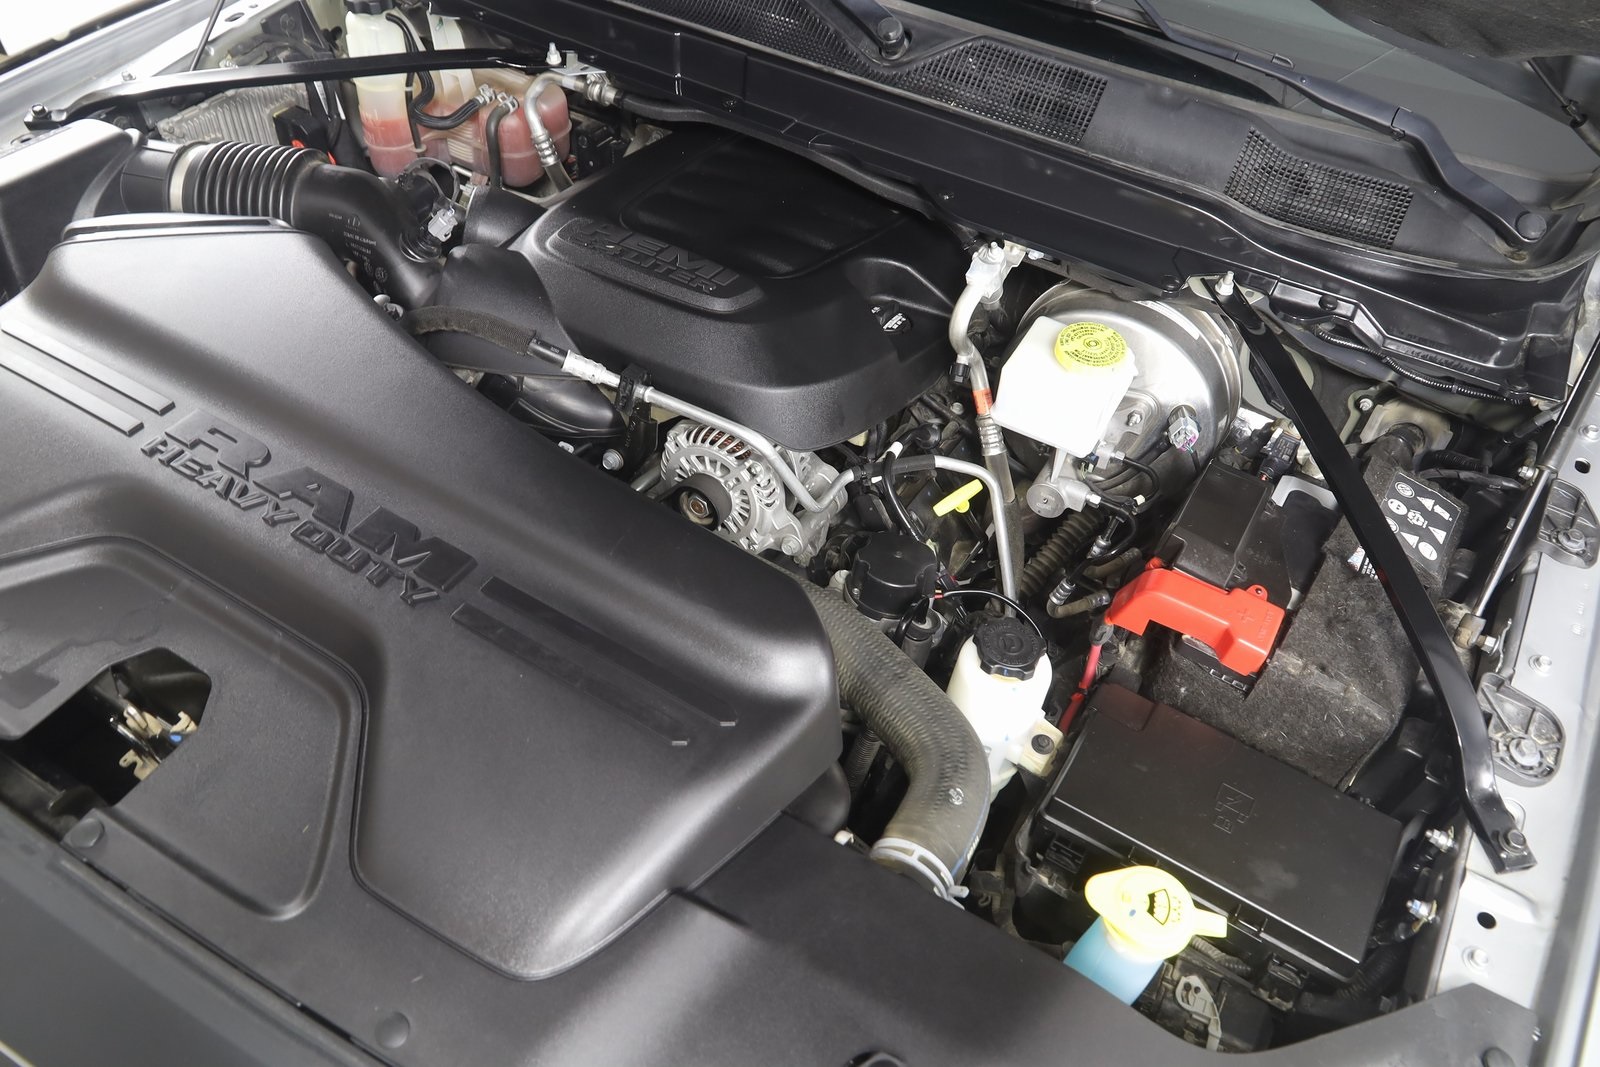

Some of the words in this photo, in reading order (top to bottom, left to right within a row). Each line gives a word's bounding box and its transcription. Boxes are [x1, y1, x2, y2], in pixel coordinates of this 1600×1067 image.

[580, 222, 740, 286] HEMI
[140, 434, 299, 527] HEAVY
[290, 519, 440, 607] DUTY
[165, 409, 478, 592] RAM
